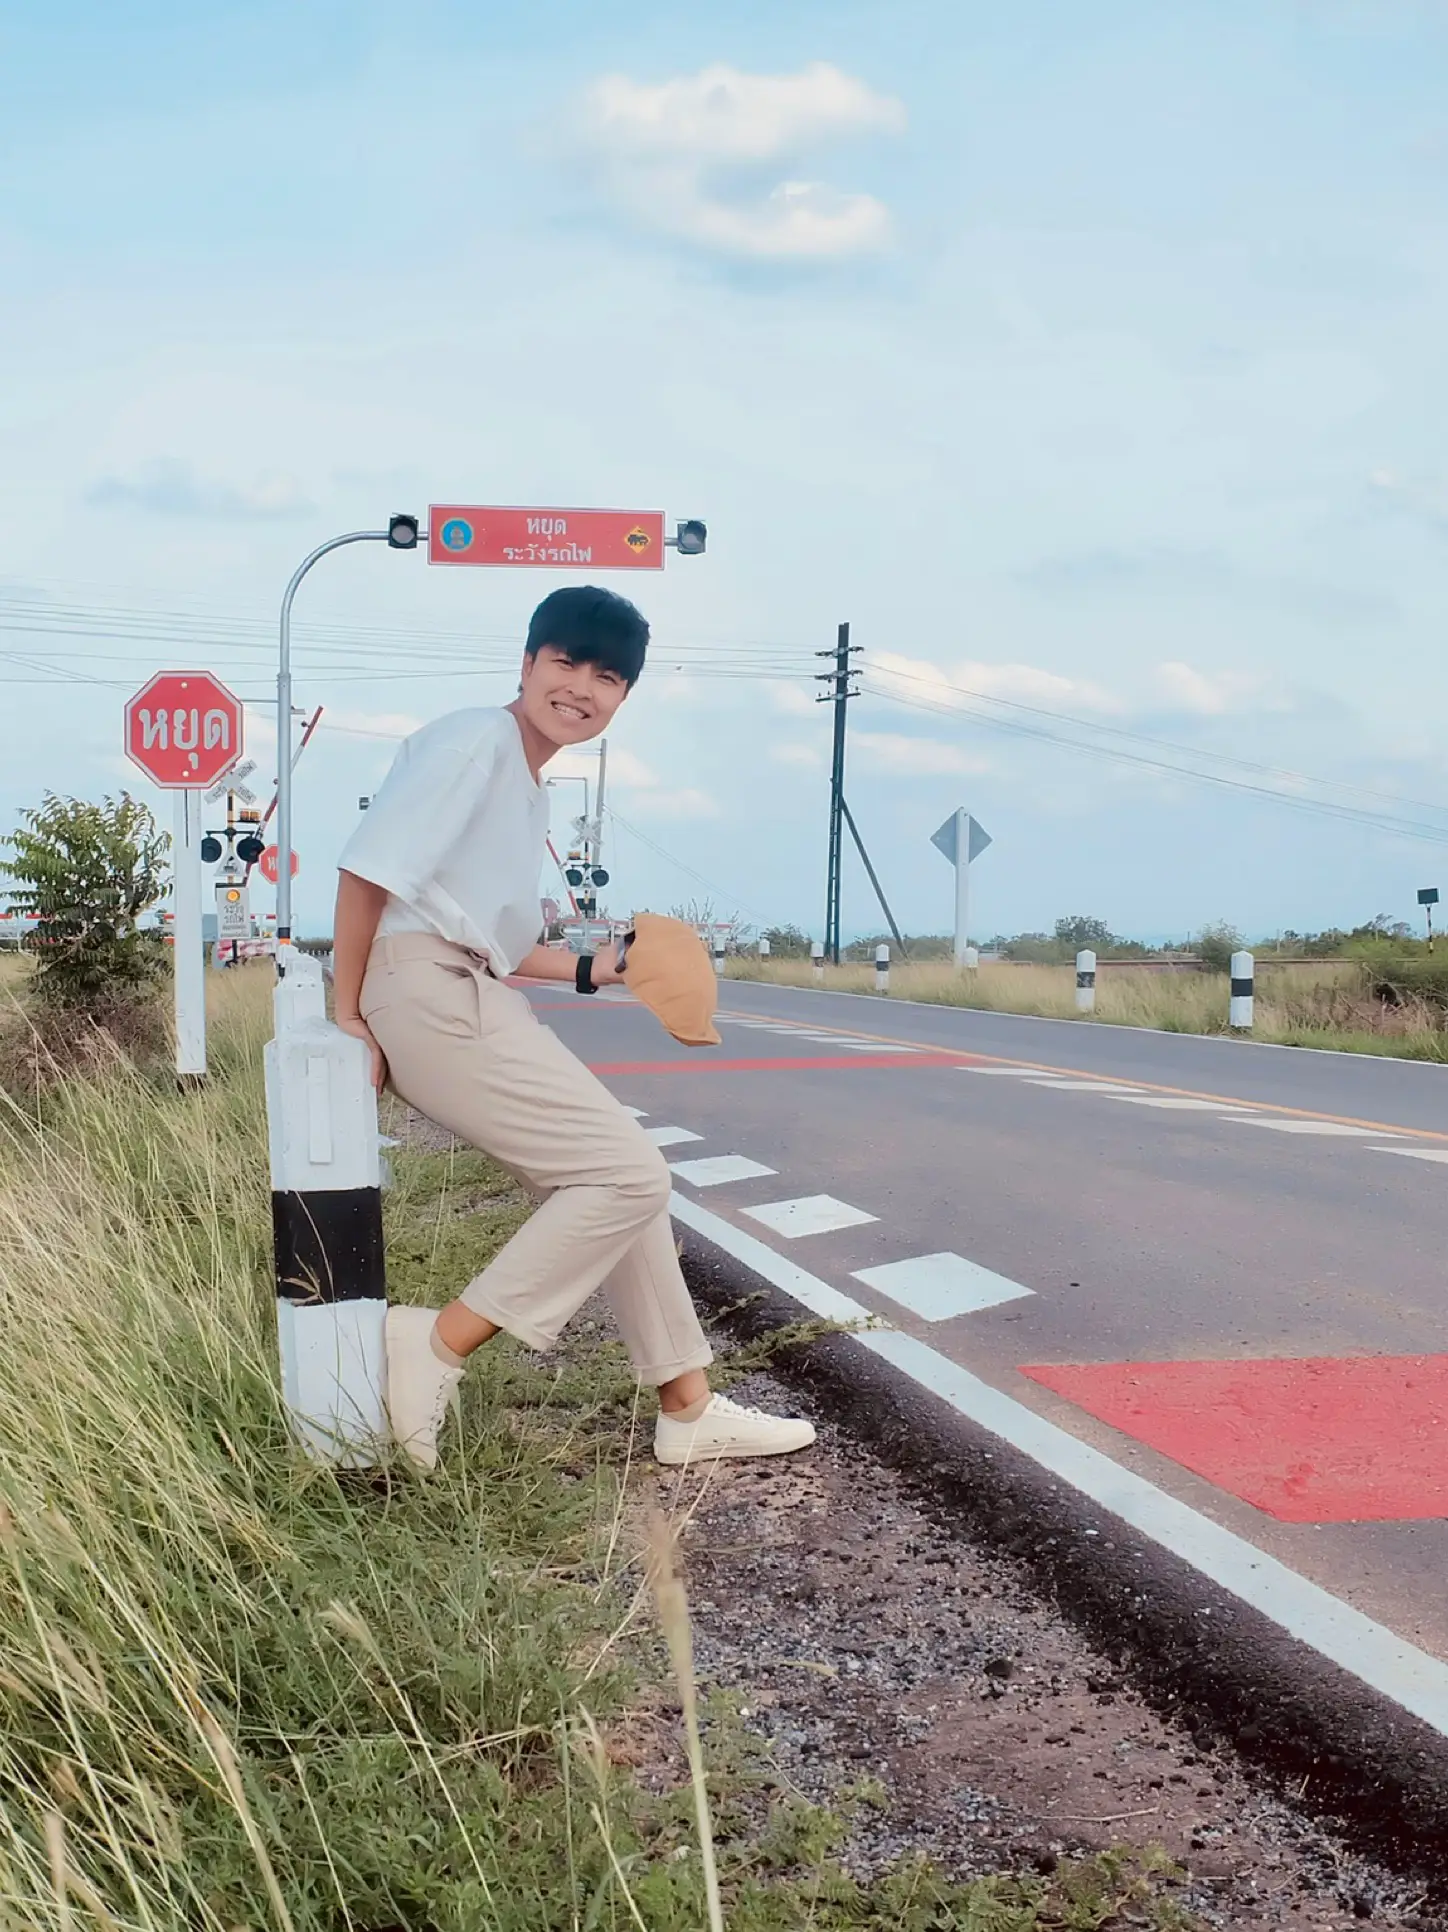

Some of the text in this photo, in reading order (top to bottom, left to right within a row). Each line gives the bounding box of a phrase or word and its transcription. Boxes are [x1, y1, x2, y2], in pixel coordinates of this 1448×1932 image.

[526, 517, 567, 542] หยุด
[502, 542, 592, 562] ระวังรถไฟ
[138, 708, 229, 770] หยุด
